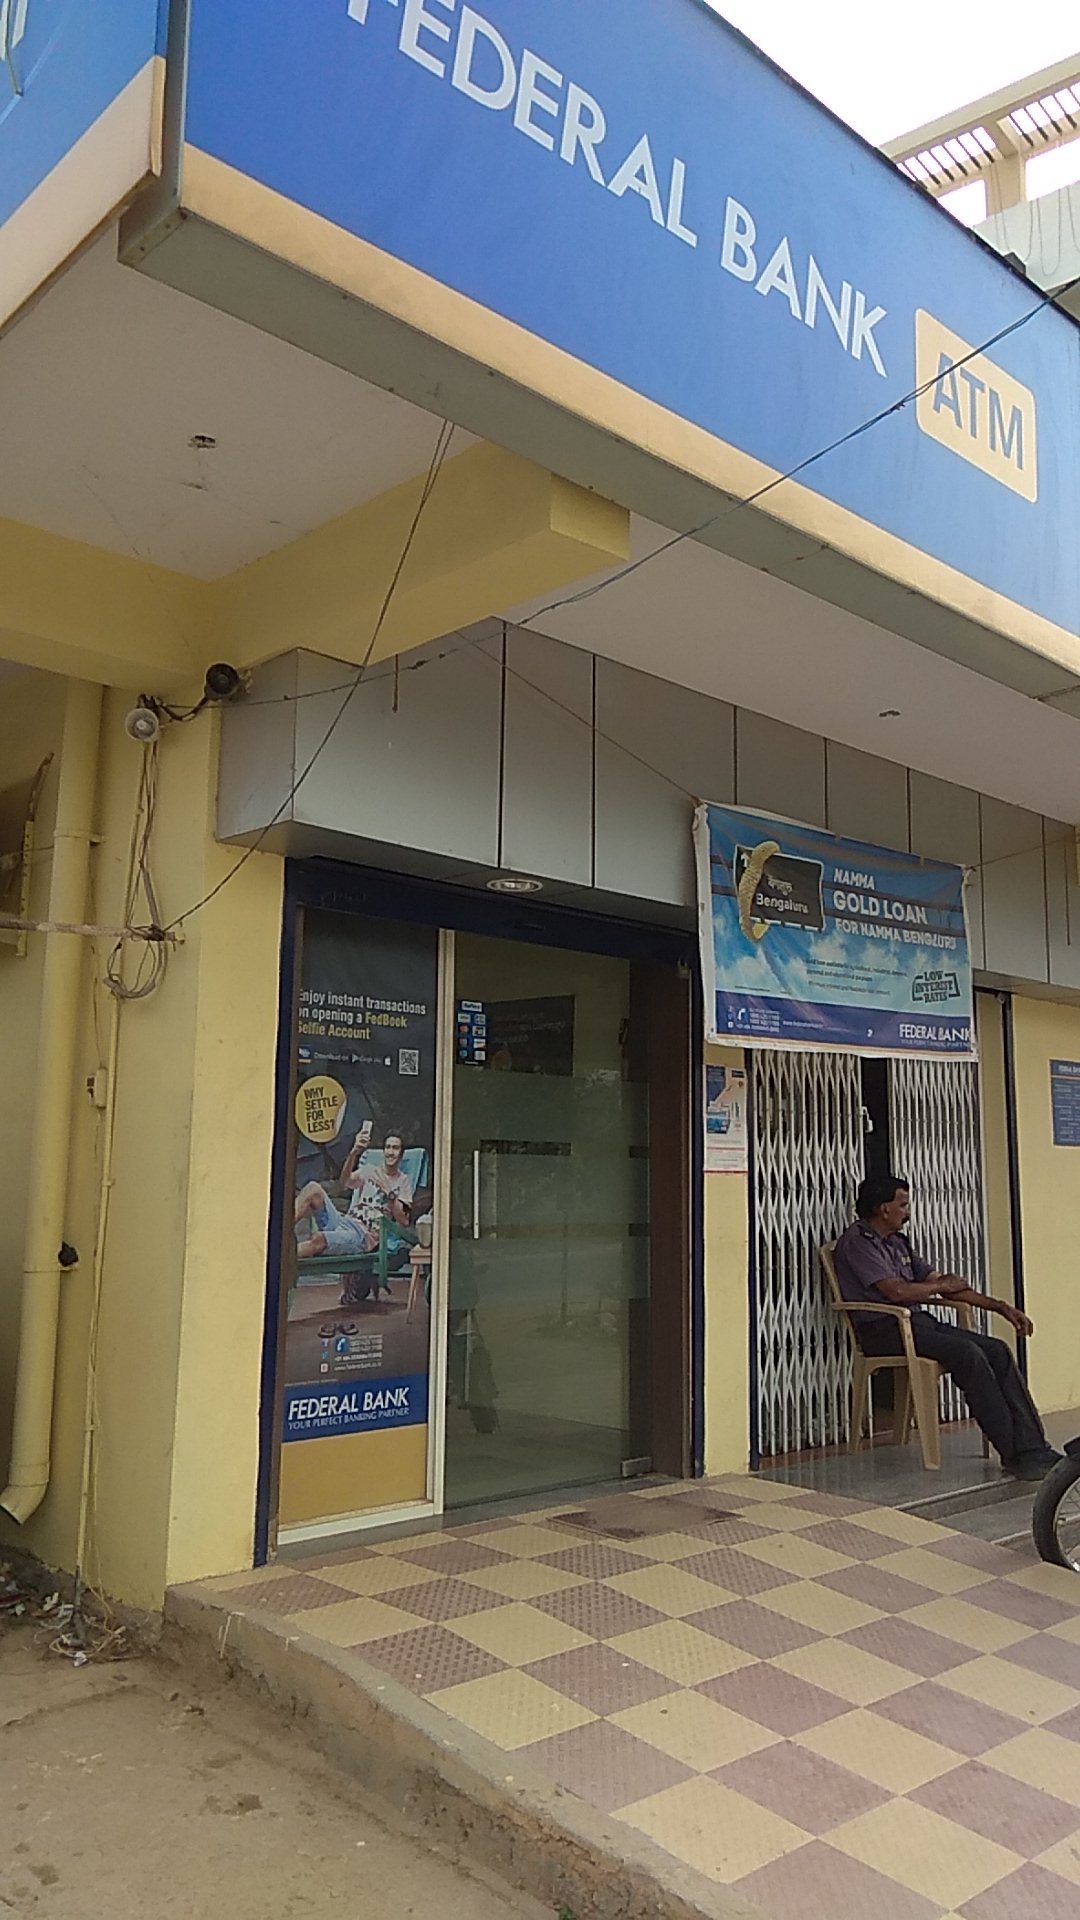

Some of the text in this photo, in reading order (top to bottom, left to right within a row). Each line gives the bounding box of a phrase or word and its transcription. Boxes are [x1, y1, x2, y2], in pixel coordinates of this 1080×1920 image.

[347, 0, 888, 379] EDERAL BANK
[932, 352, 1024, 471] ATM
[833, 868, 875, 890] NAMMA
[756, 893, 809, 914] Bengaluru
[833, 890, 929, 924] GOLD LOAN
[836, 919, 957, 950] FOR NAMMA BENGLURU
[924, 970, 944, 981] LOW
[915, 980, 953, 993] INTEREST
[327, 991, 364, 1008] instant
[366, 996, 427, 1015] transactions
[311, 1008, 354, 1025] opening
[356, 1013, 363, 1024] a
[365, 1011, 408, 1028] FedBook
[328, 1023, 371, 1040] Account
[899, 1023, 971, 1042] FEDERAL BANK
[303, 1086, 325, 1100] WHY
[304, 1095, 339, 1111] SETTLE
[306, 1109, 325, 1122] FOR
[307, 1119, 336, 1134] LESS?
[288, 1386, 410, 1421] FEDERAL BANK
[288, 1406, 410, 1431] YOUR PERFECT BANKING PARTNER
